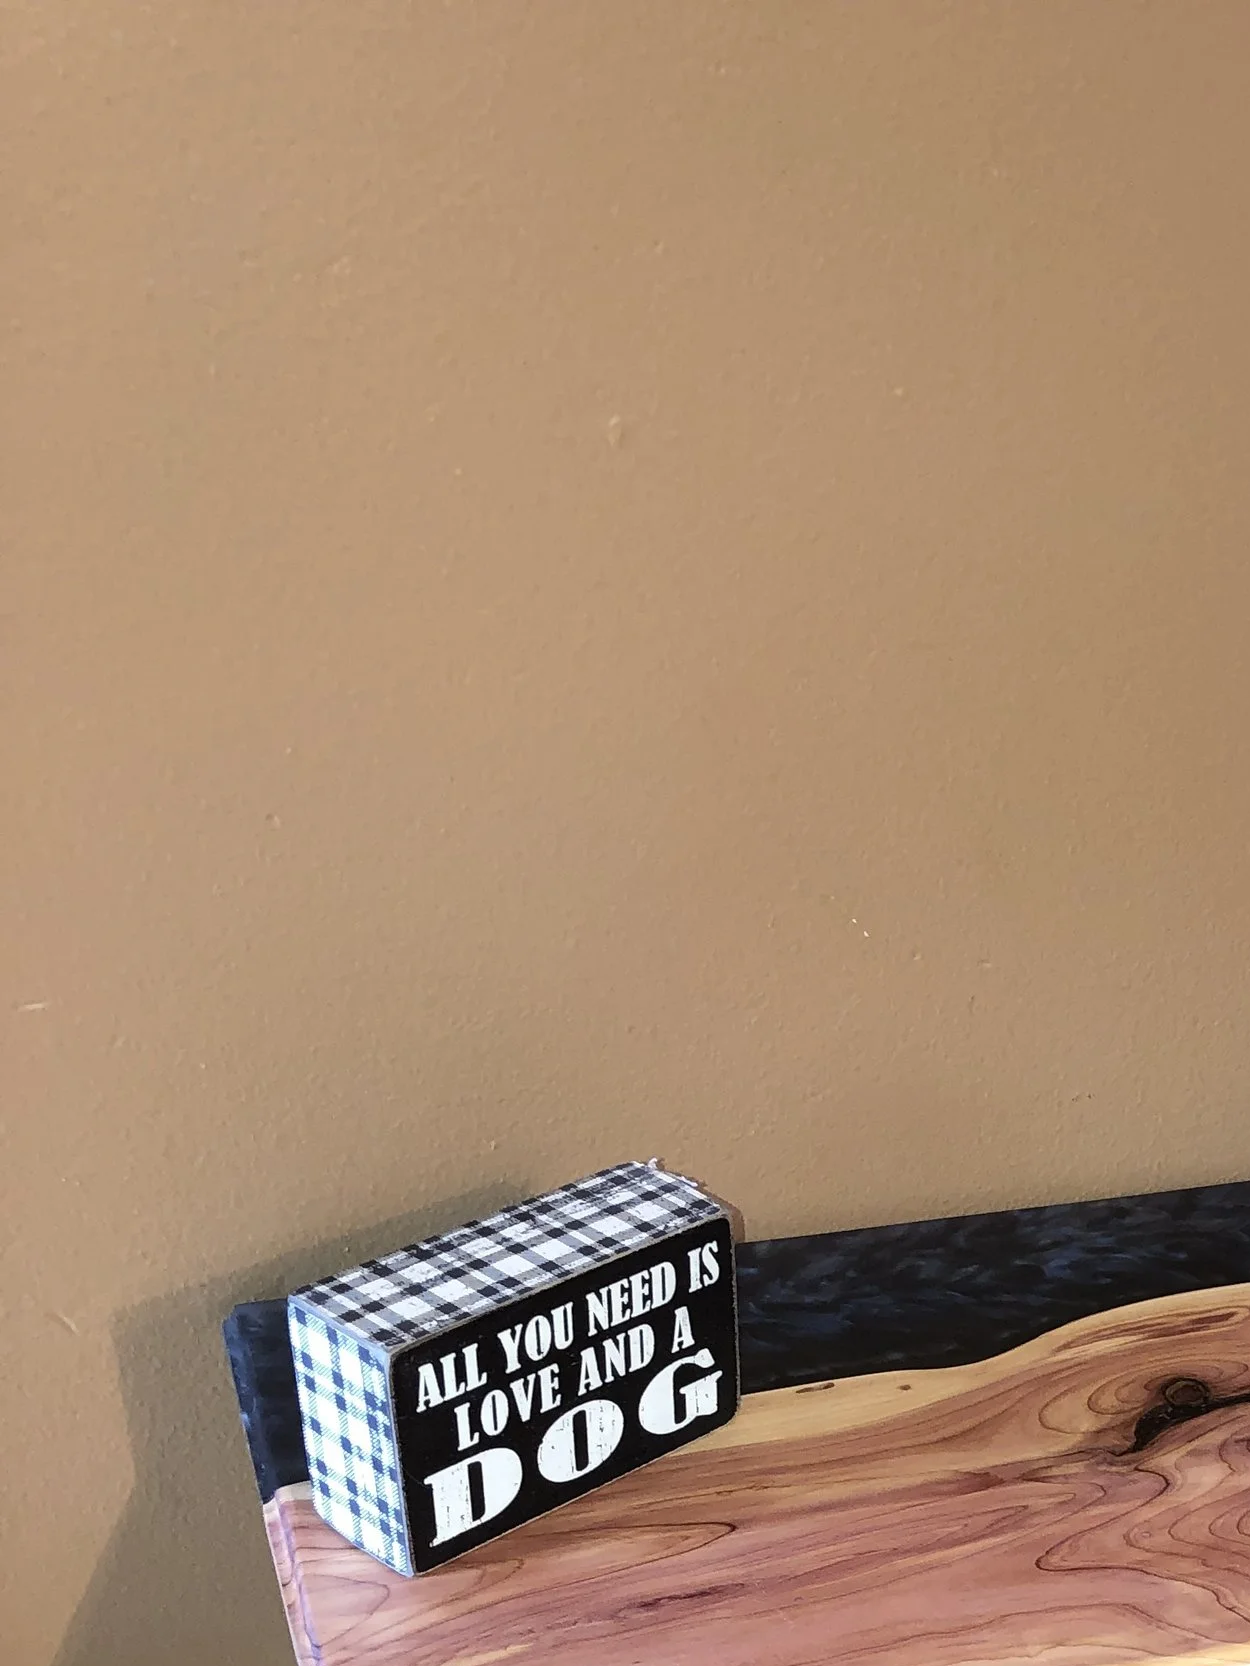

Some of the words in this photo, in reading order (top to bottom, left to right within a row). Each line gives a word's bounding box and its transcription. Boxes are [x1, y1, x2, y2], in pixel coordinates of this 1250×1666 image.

[416, 1343, 488, 1413] ALL
[497, 1302, 574, 1374] YOU
[586, 1261, 677, 1336] NEED
[688, 1240, 720, 1293] IS
[453, 1363, 562, 1451] LOVE
[577, 1323, 655, 1396] AND
[671, 1306, 695, 1353] A
[423, 1348, 723, 1548] DOG
